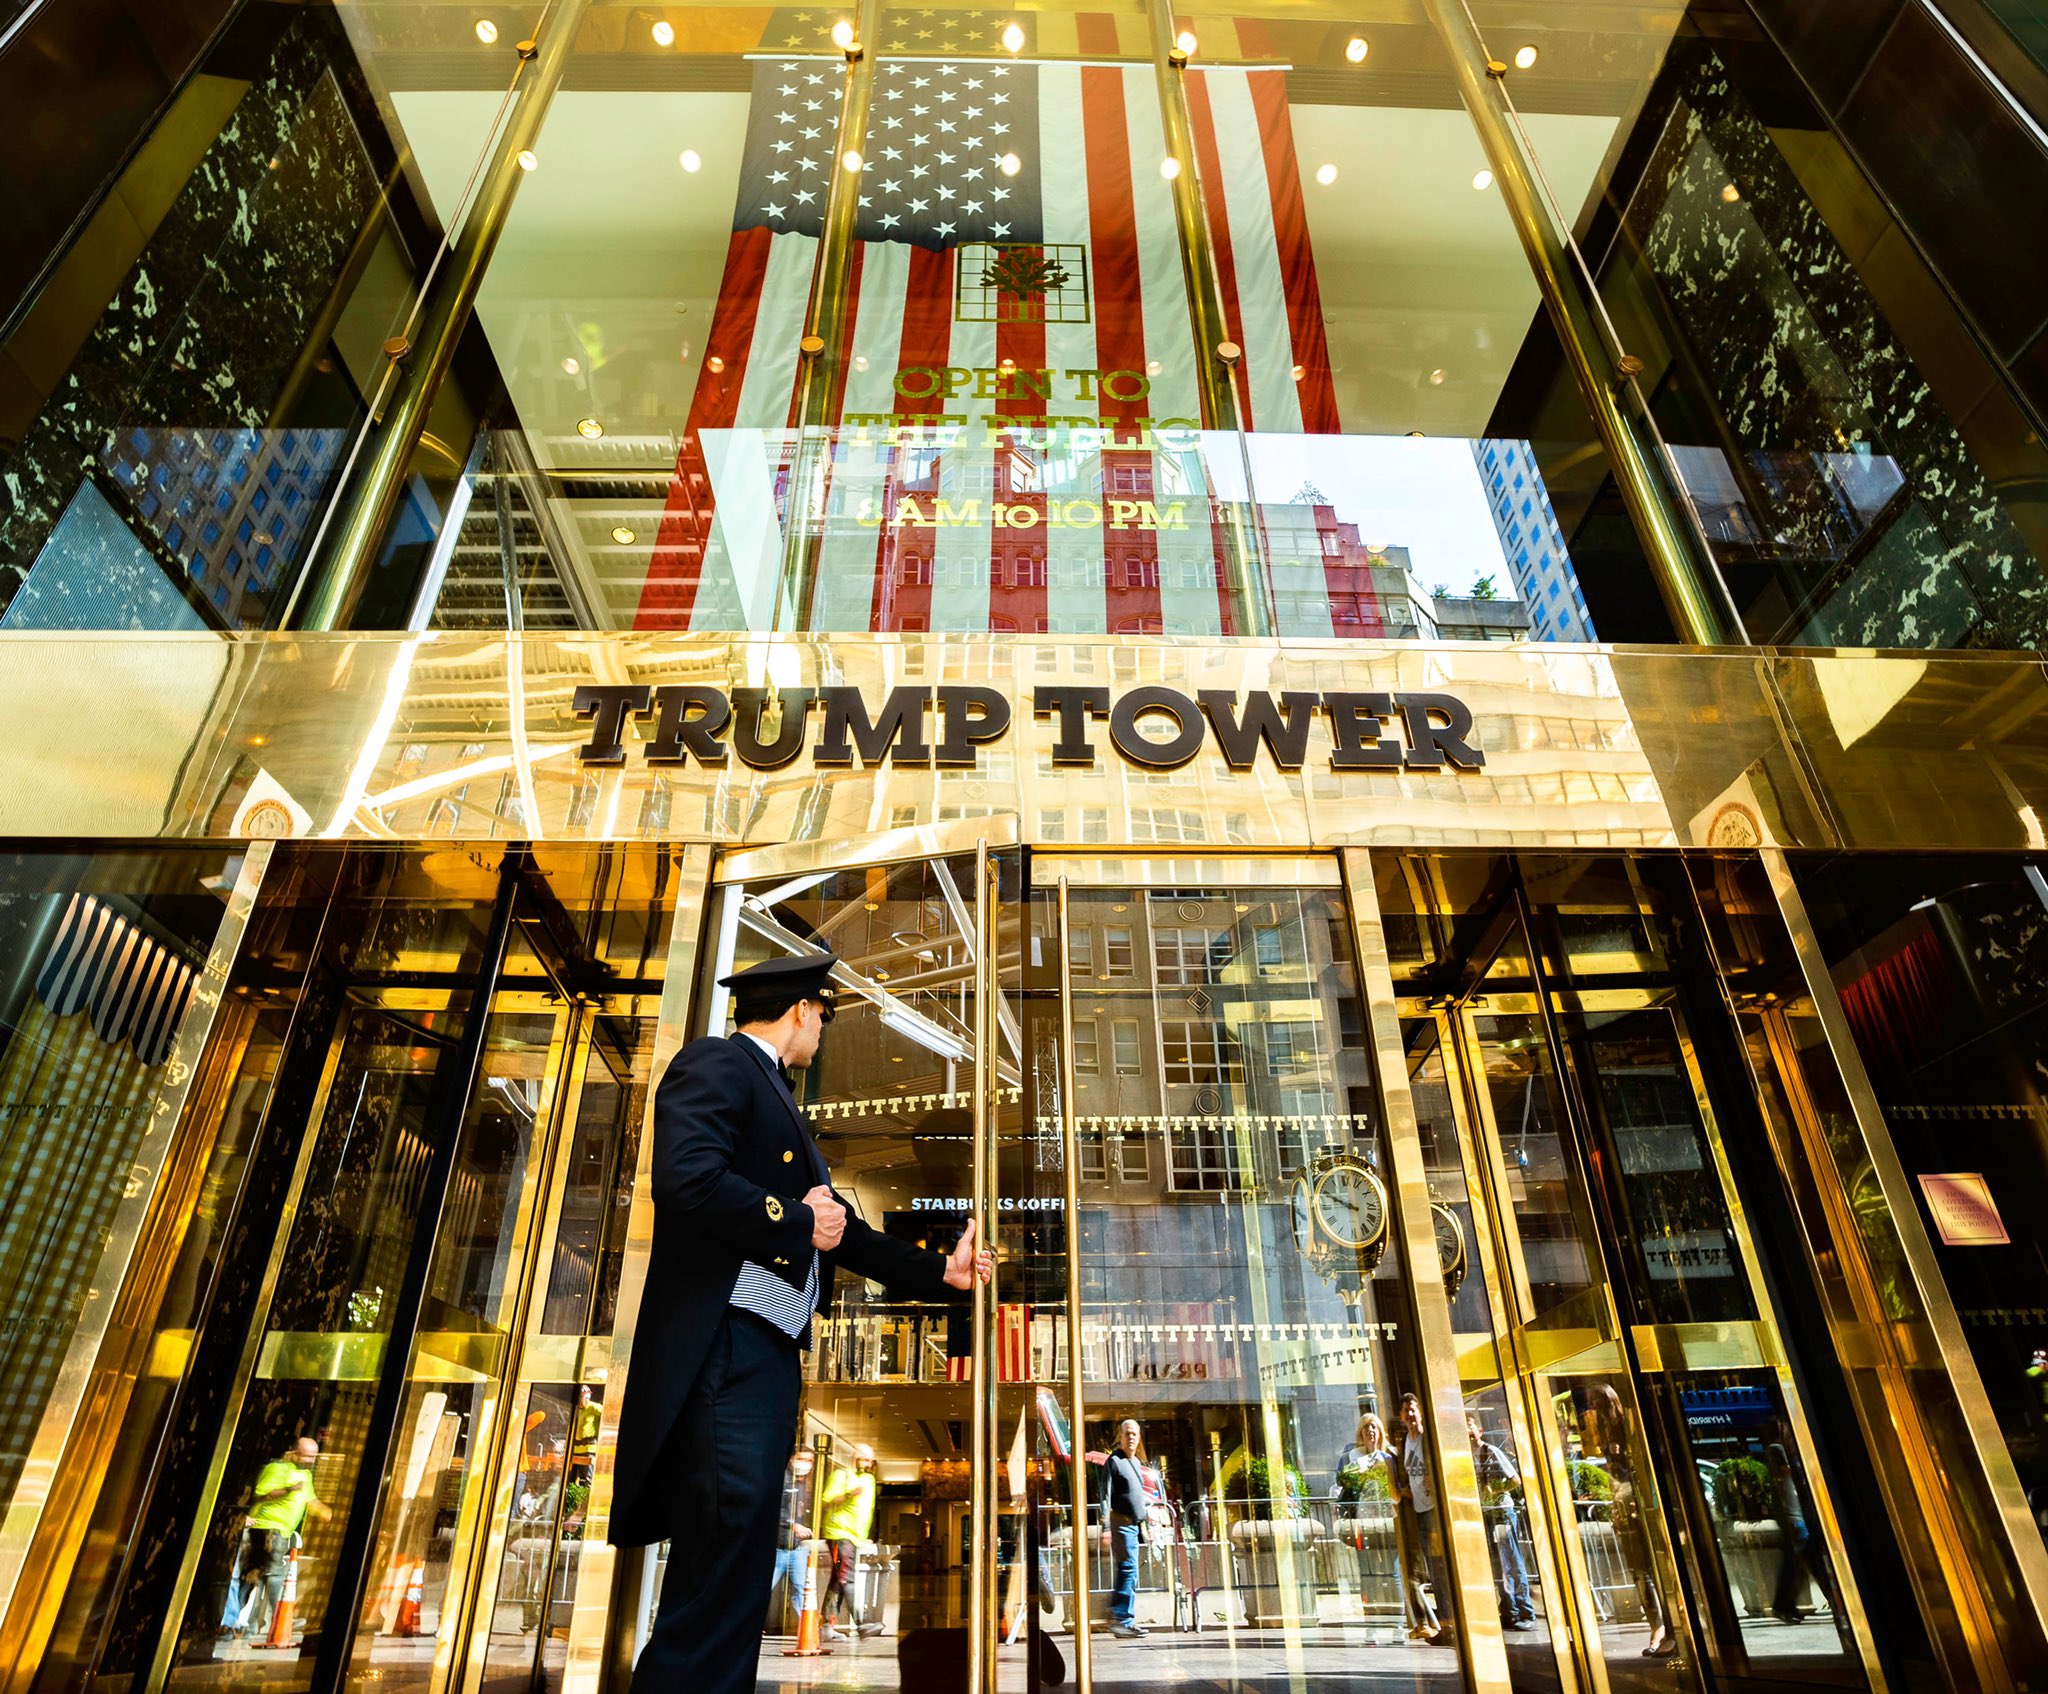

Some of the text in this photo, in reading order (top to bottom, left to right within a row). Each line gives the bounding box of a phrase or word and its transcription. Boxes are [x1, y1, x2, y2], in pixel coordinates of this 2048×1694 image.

[892, 367, 1151, 402] OPEN TO
[843, 413, 1201, 451] THE PUBLIC
[991, 503, 1040, 529] to
[1046, 500, 1102, 529] 10
[1107, 500, 1190, 530] PM
[571, 685, 1487, 771] TRUMP TOWER
[911, 1197, 1081, 1211] STARBKS COFF
[1968, 1220, 1990, 1228] POINT
